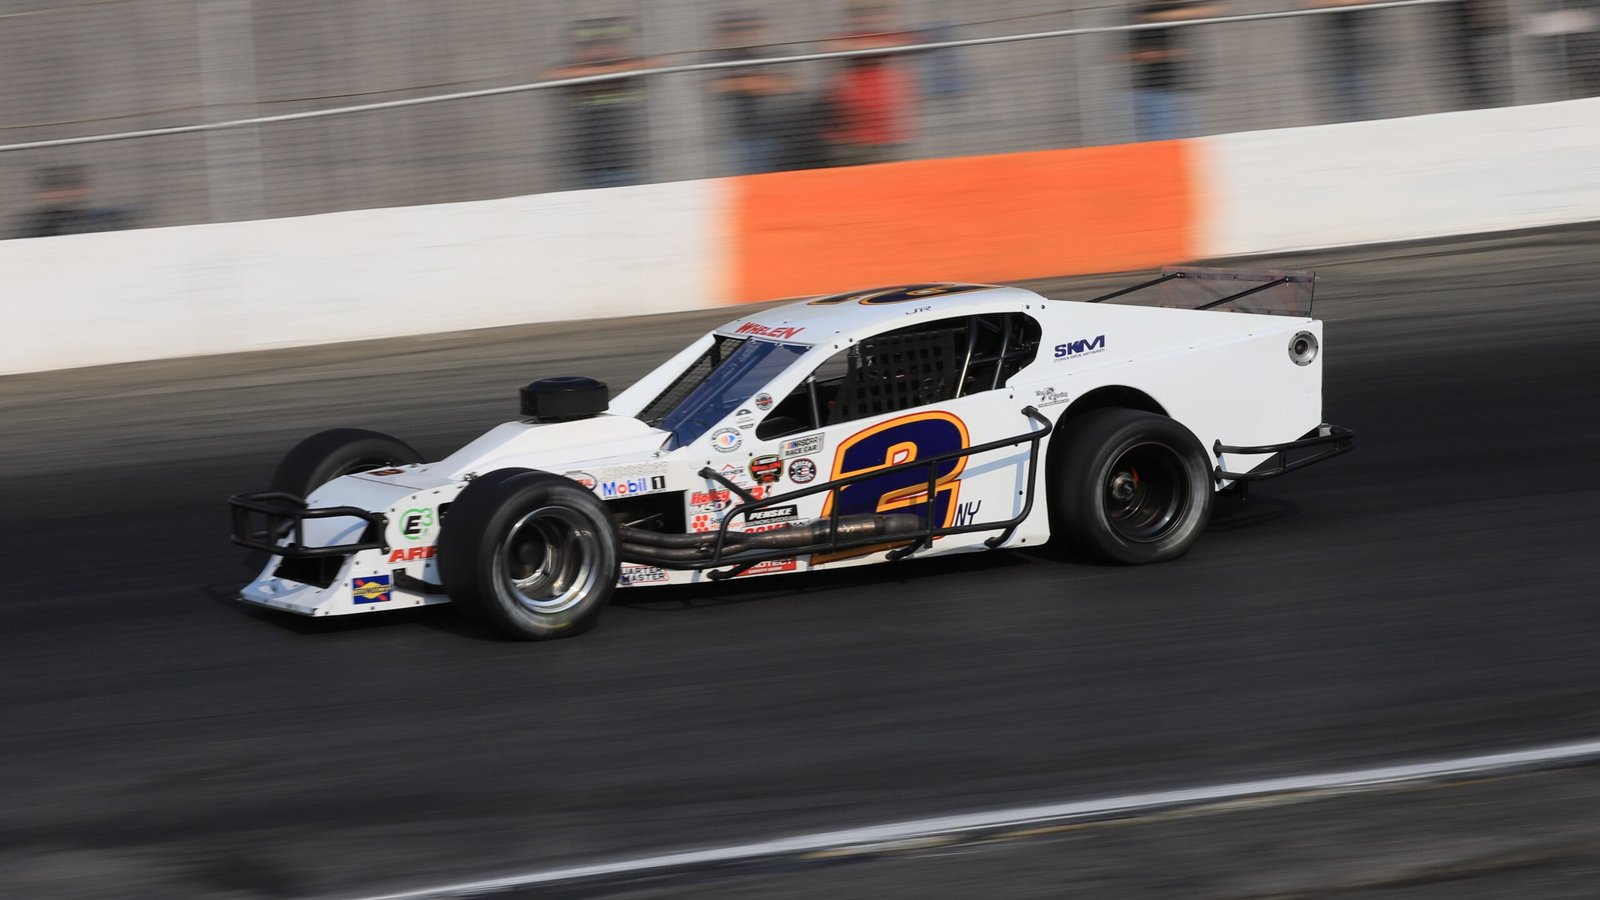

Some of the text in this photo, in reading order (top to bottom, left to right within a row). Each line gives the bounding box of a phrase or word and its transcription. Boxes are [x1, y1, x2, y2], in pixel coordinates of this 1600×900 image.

[905, 305, 932, 316] JR
[735, 322, 806, 339] WHELEN
[1054, 335, 1105, 358] SKM
[785, 447, 802, 456] RACE
[602, 478, 647, 497] Mobil
[653, 476, 665, 489] 1
[811, 410, 970, 566] 2
[749, 508, 793, 520] PENSKE
[956, 500, 982, 527] NY
[621, 566, 663, 576] UARTER
